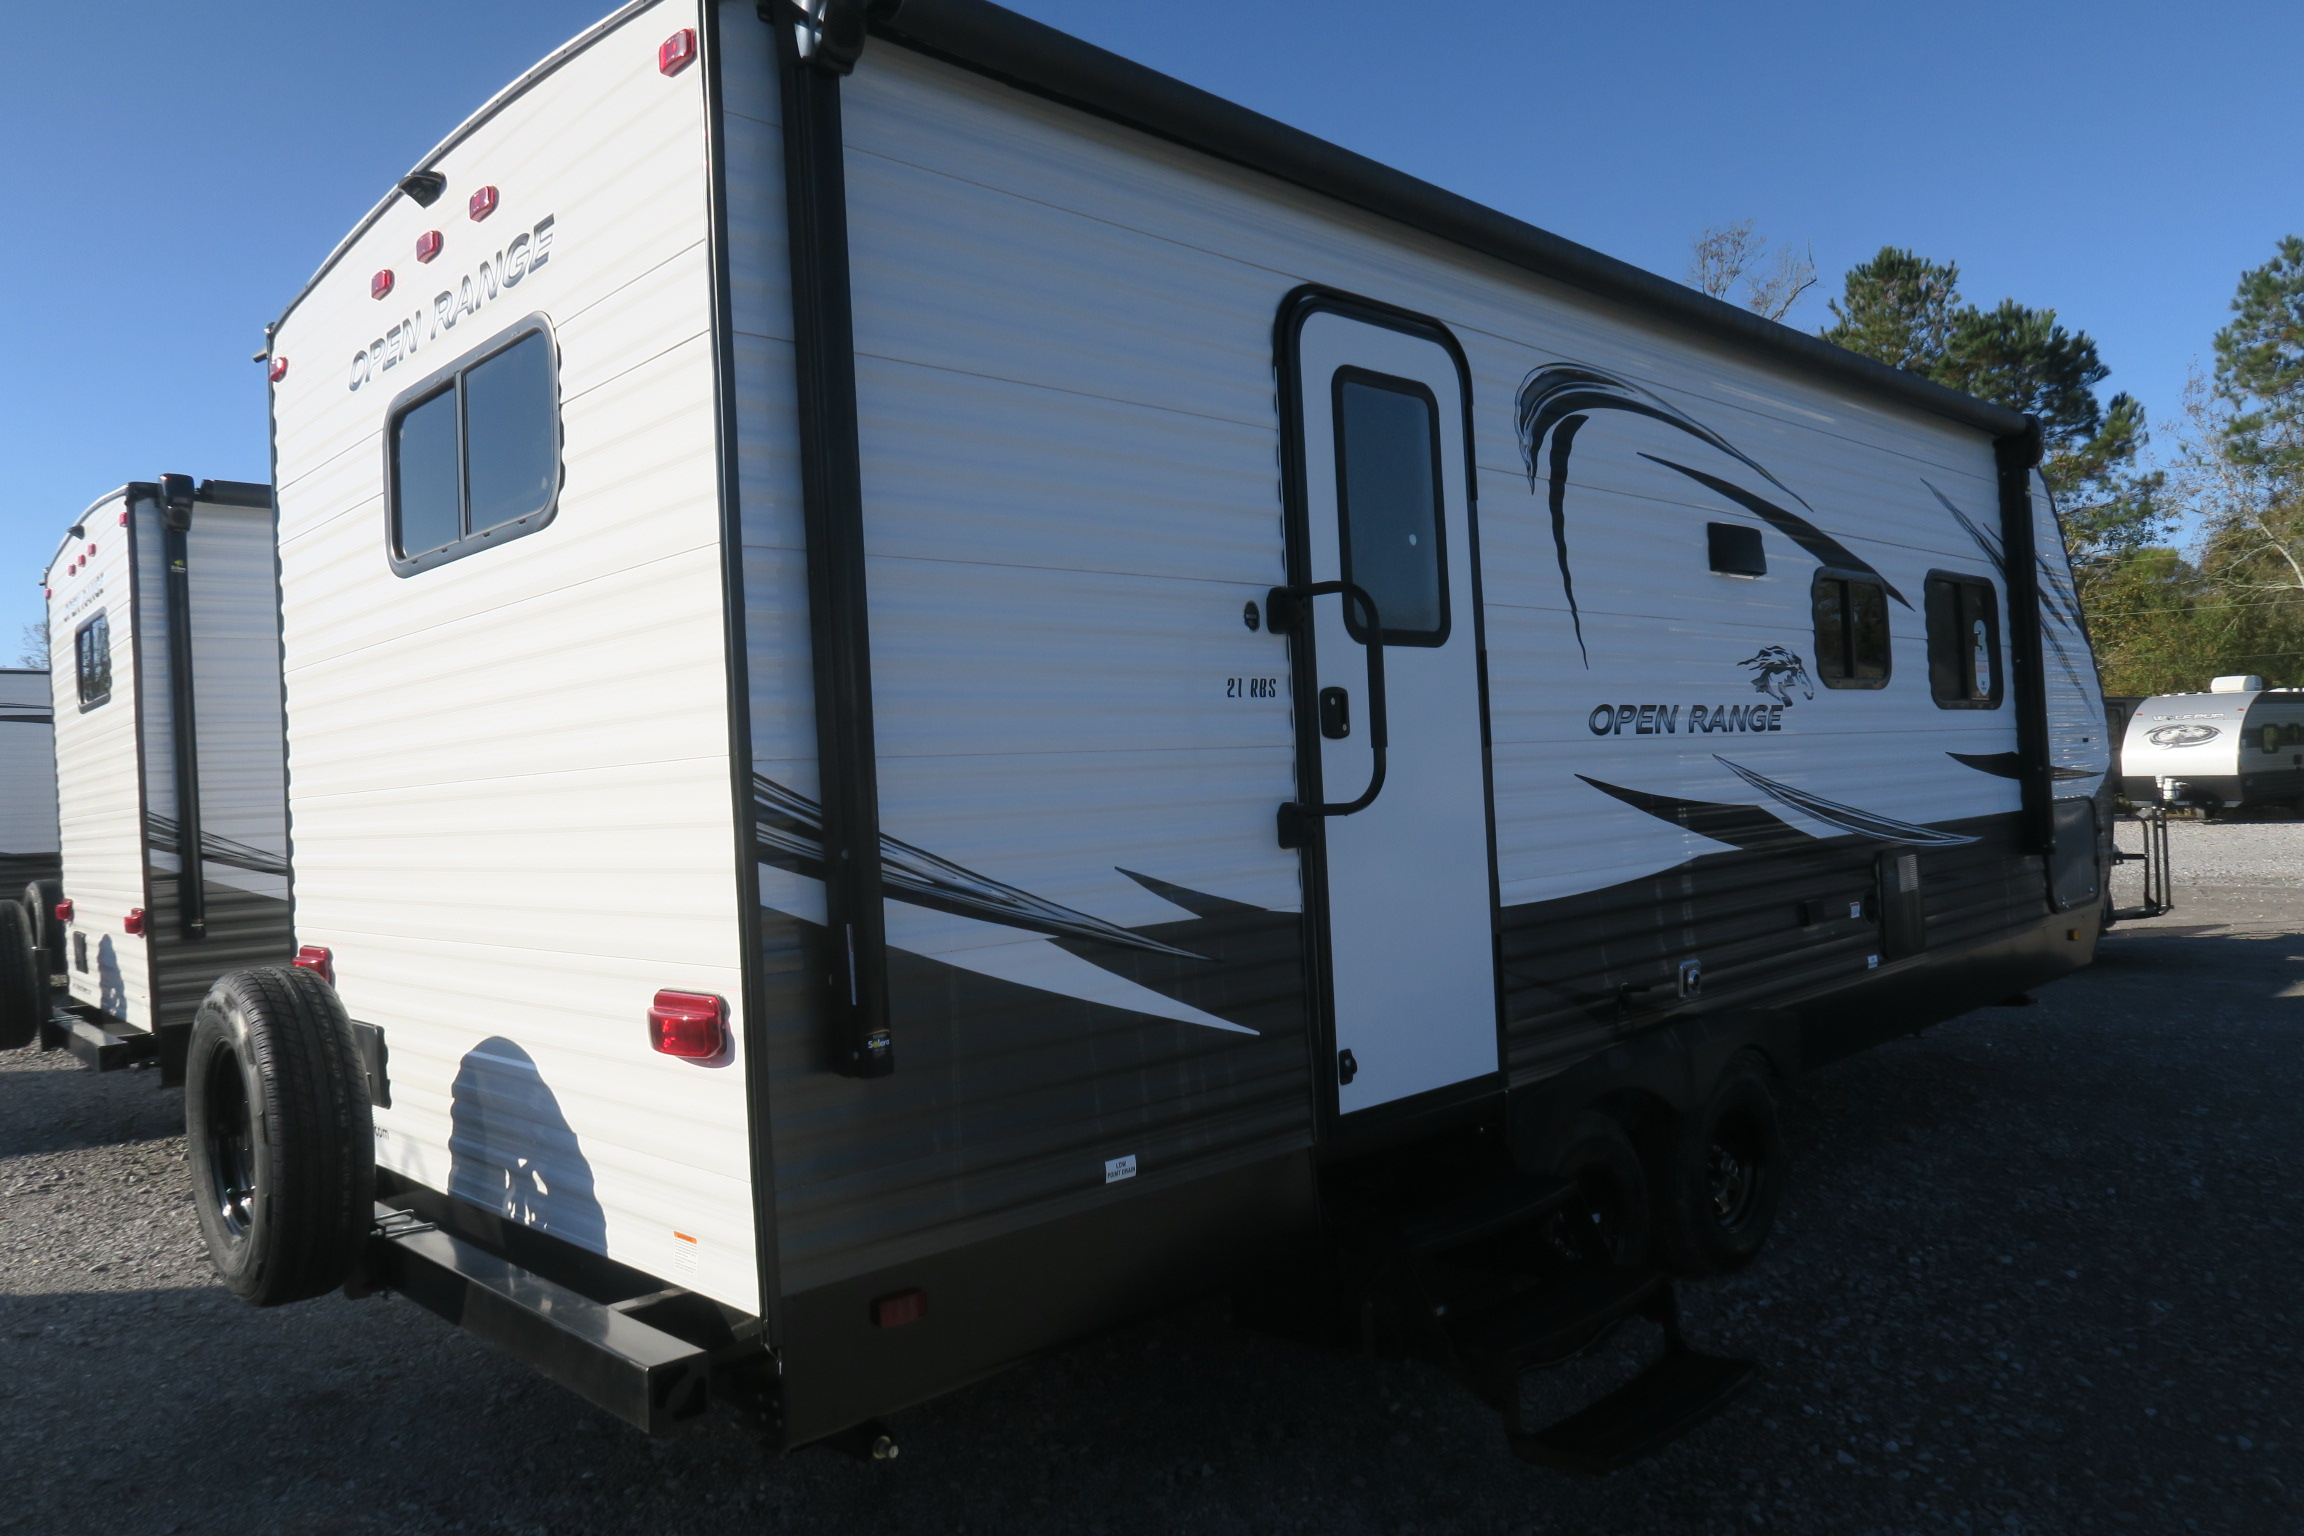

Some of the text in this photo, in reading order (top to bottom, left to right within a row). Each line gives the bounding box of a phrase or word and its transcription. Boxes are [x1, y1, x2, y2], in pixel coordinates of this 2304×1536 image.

[349, 213, 555, 392] OPEN RANGE
[1226, 677, 1277, 698] 21 RBS
[1588, 703, 1784, 736] OPEN RANGE
[867, 1038, 891, 1049] Solera
